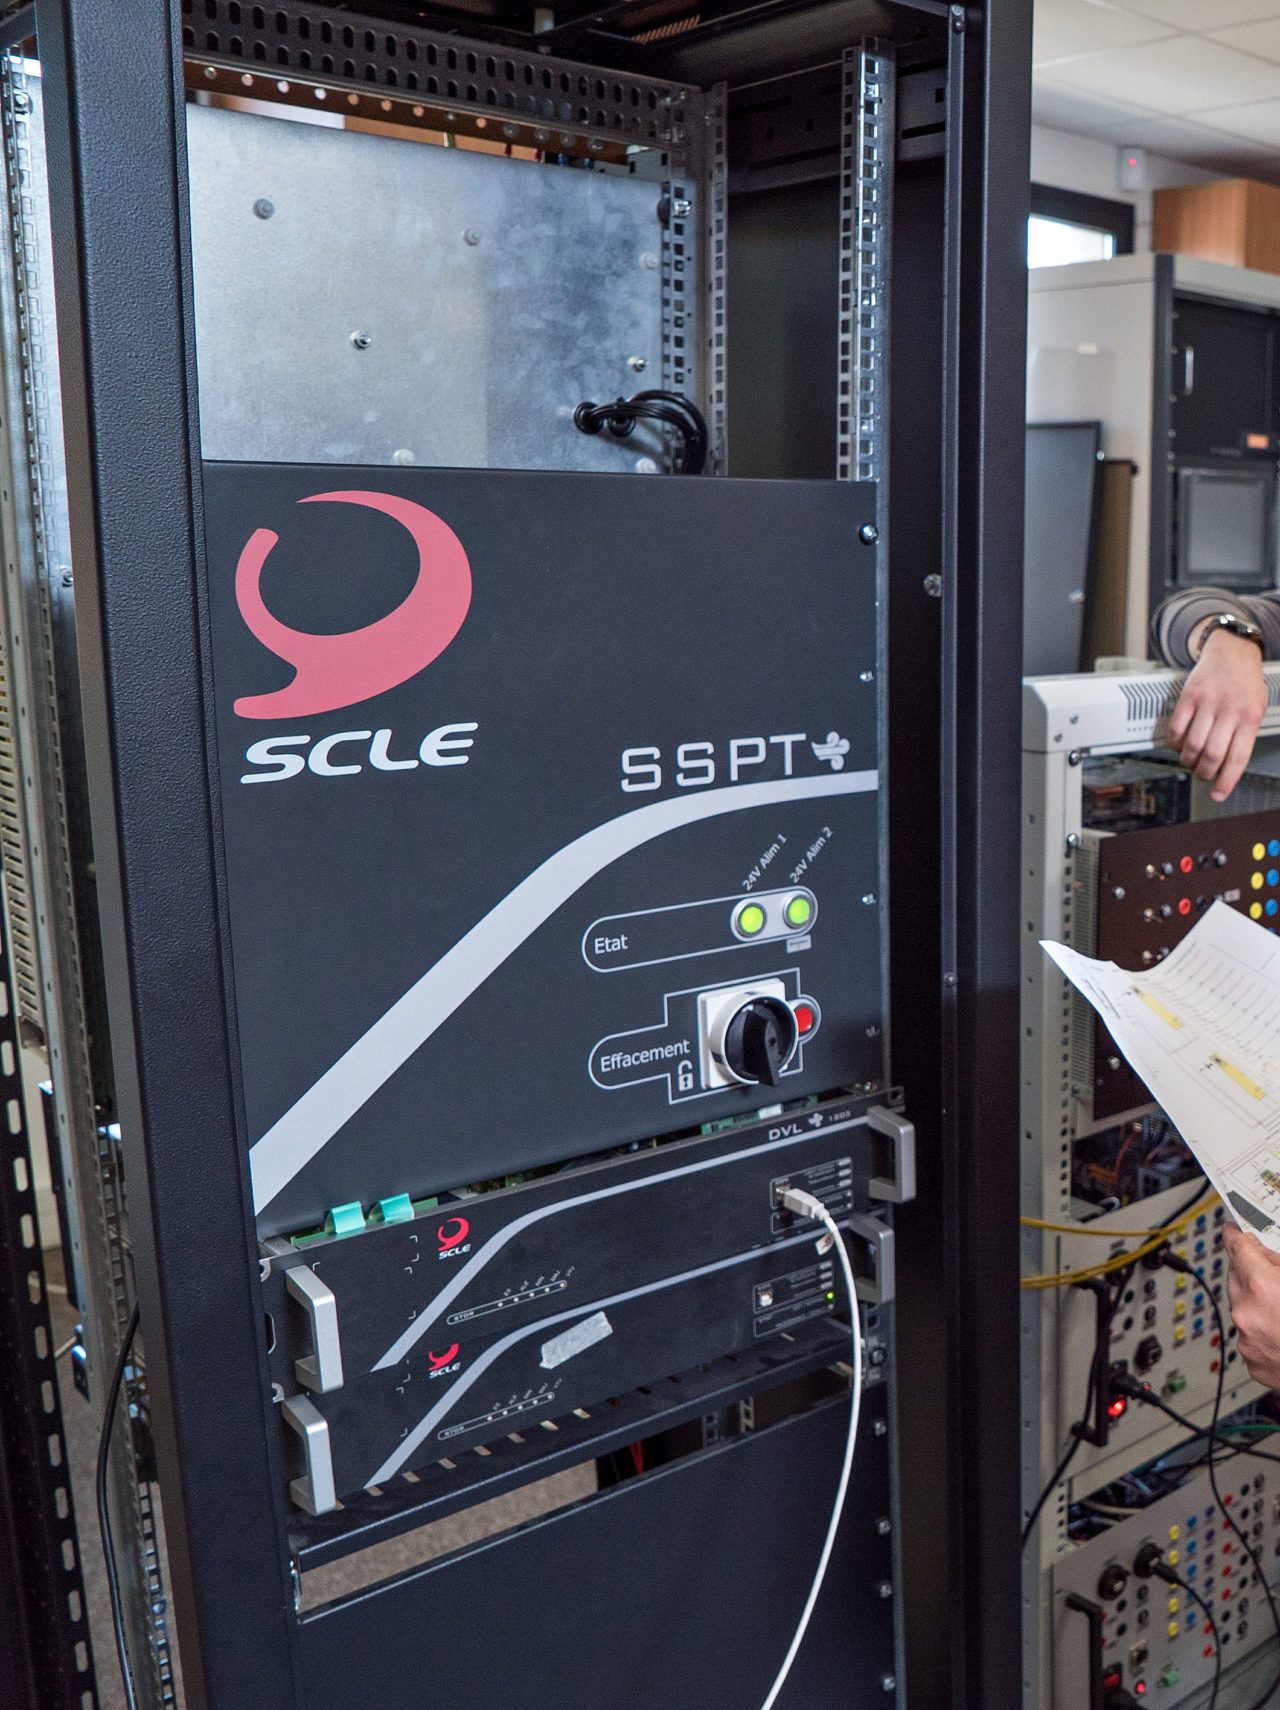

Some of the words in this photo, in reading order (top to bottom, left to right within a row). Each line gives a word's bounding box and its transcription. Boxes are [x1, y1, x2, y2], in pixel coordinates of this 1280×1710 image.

[240, 722, 479, 784] SCLE
[742, 865, 761, 891] 24V
[760, 843, 781, 869] Alim
[777, 833, 787, 845] 1
[789, 858, 808, 884] 24V
[806, 836, 827, 862] Alim
[822, 826, 834, 839] 2
[594, 934, 629, 955] Etat
[600, 1039, 691, 1073] Effacement
[768, 1123, 803, 1141] DVL
[438, 1243, 472, 1260] SCLE
[429, 1362, 462, 1379] SCLE
